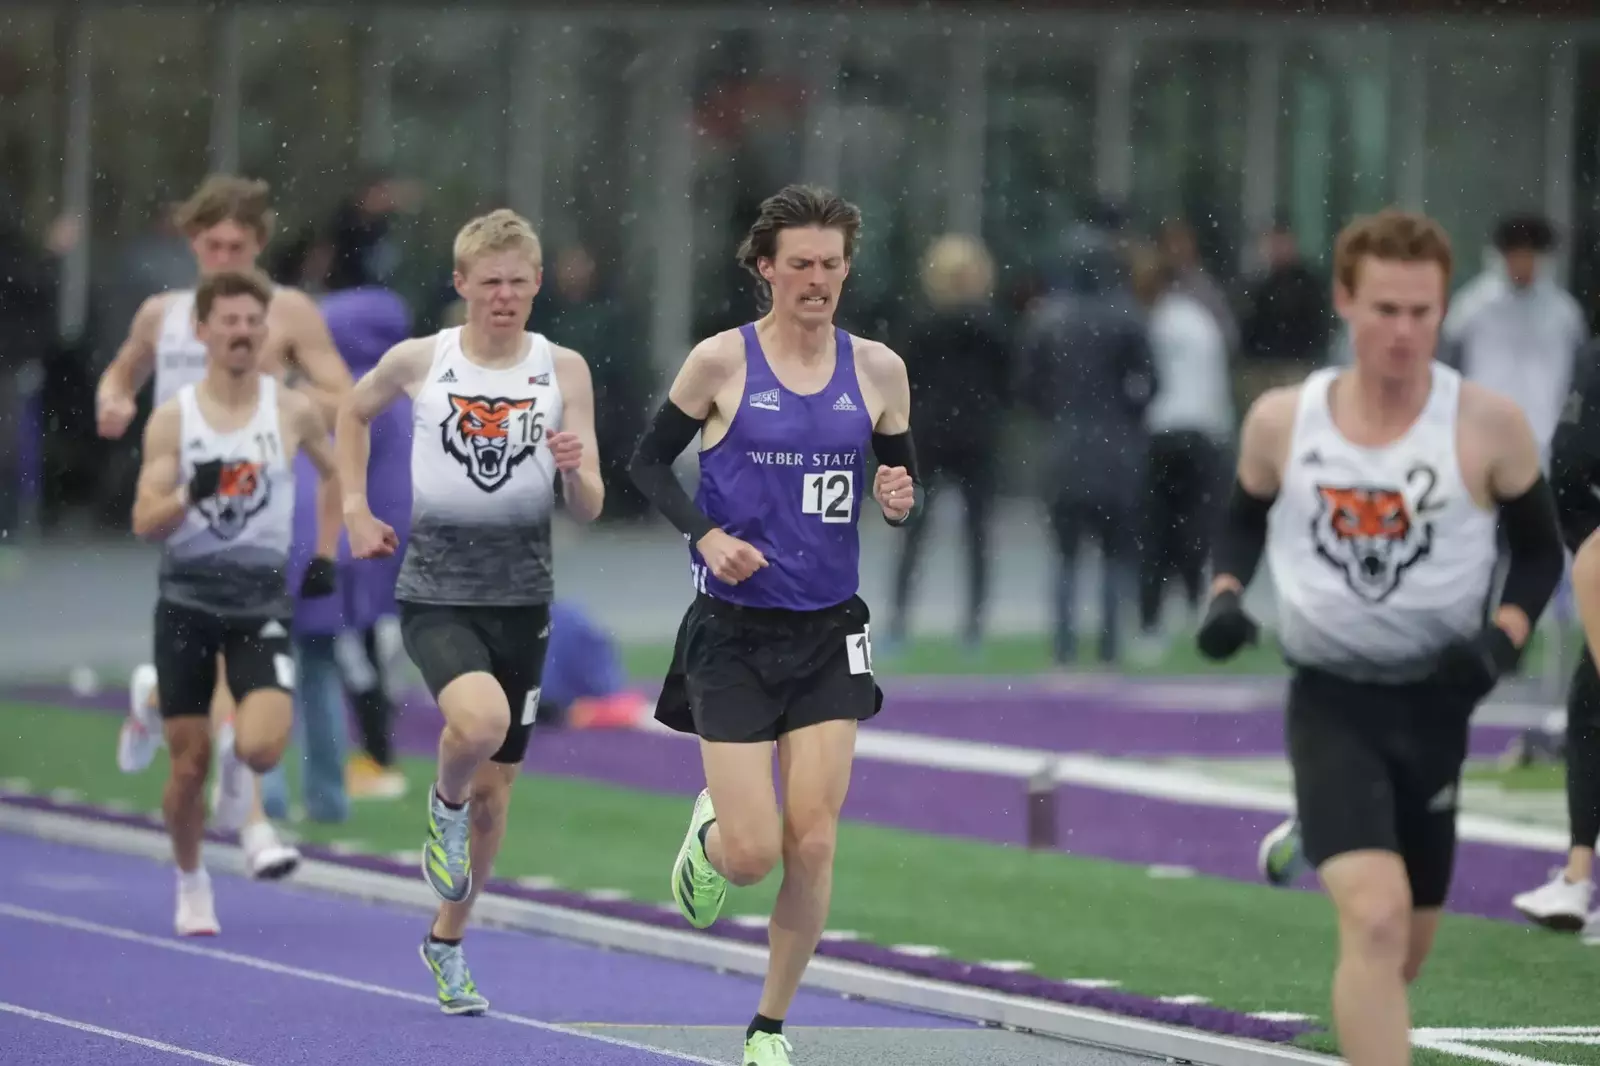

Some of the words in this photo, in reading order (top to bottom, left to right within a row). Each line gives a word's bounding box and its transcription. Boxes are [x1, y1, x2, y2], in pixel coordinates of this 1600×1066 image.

[517, 412, 545, 444] 16
[746, 451, 804, 466] WEBER
[812, 452, 857, 467] STATE
[812, 474, 850, 518] 12
[1405, 464, 1448, 515] 2
[855, 632, 871, 671] 1
